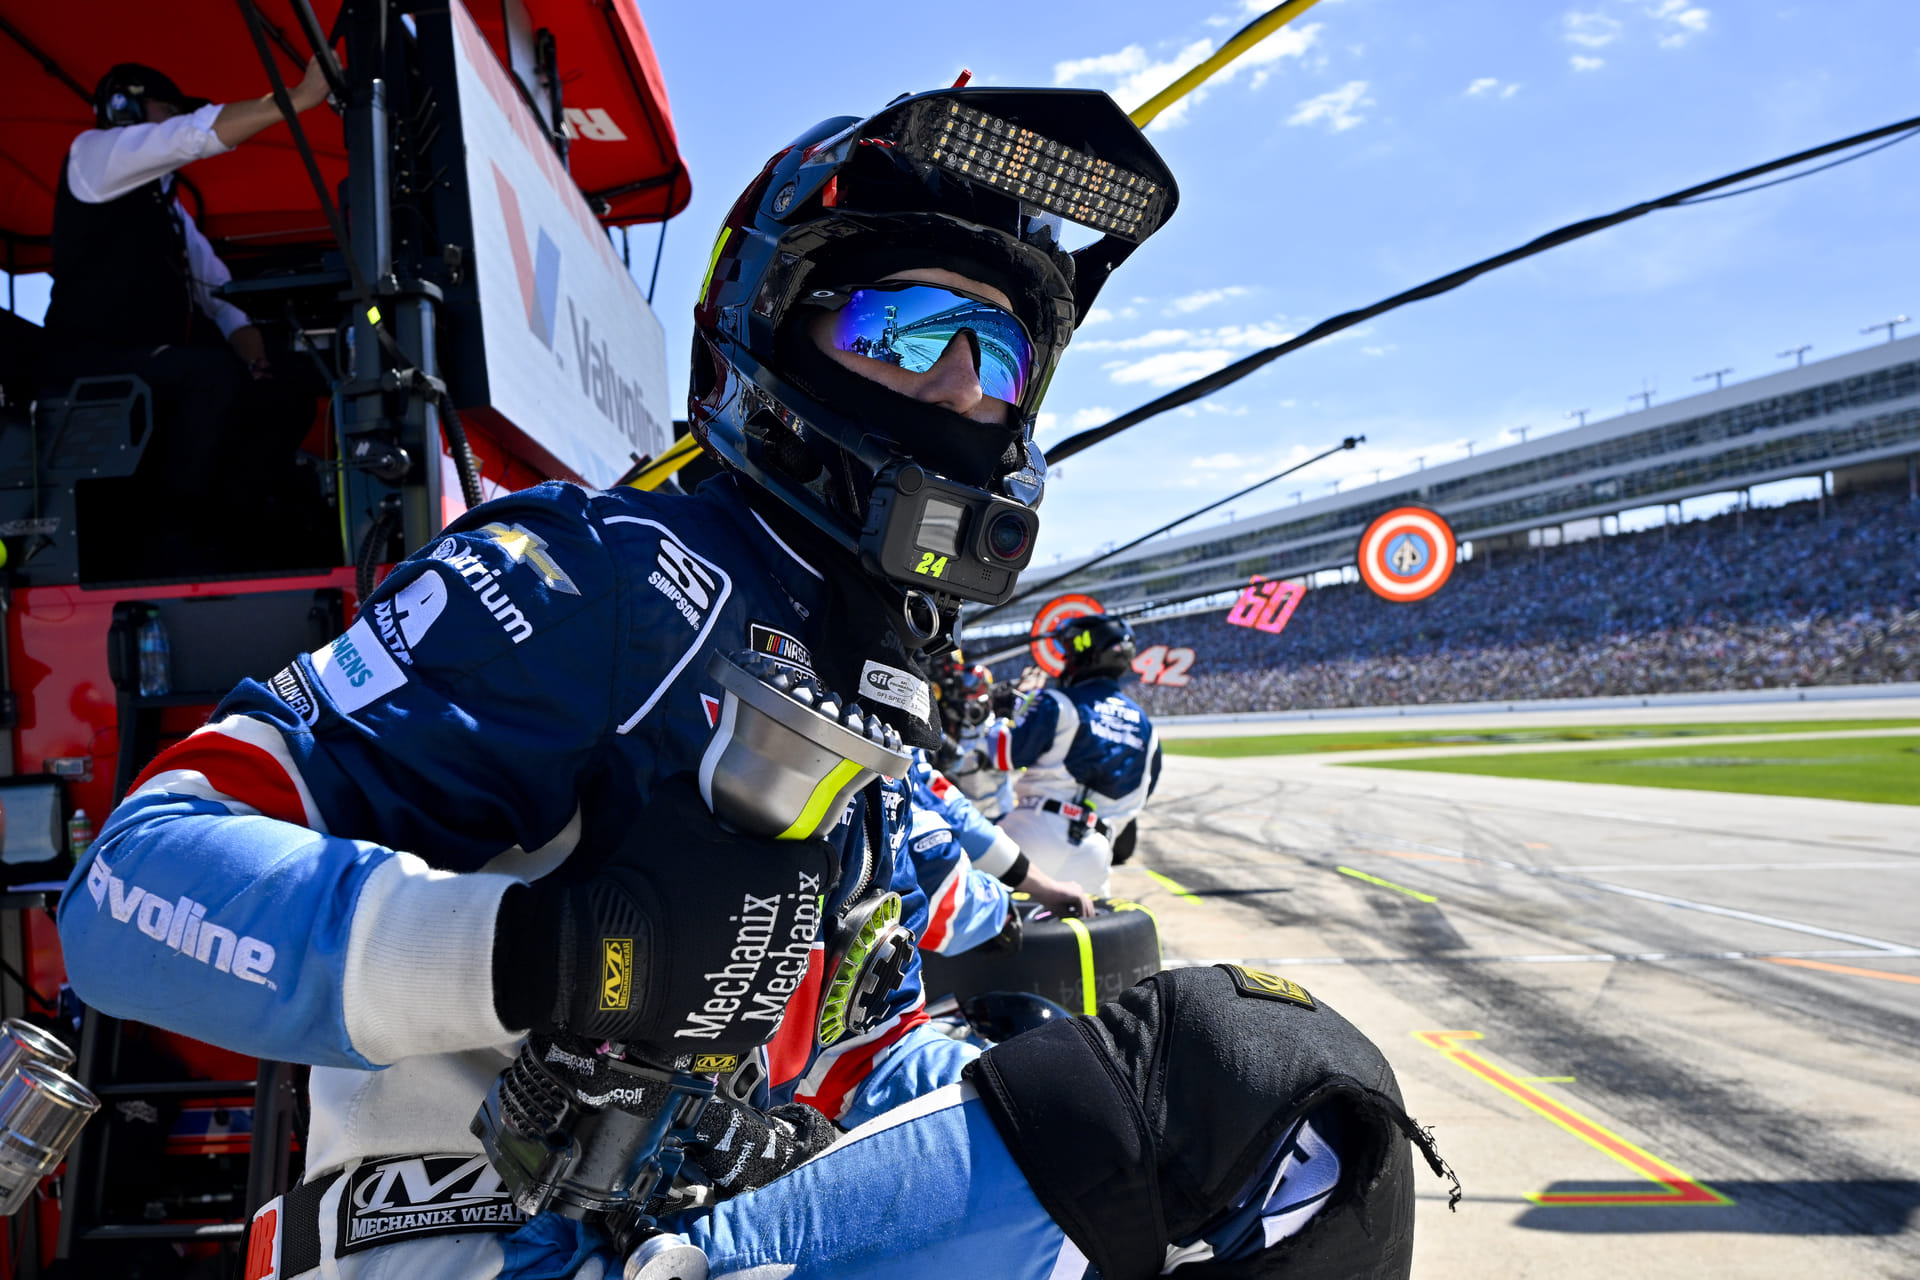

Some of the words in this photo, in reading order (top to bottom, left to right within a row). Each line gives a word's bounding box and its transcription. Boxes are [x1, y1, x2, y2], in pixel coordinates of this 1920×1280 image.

[915, 552, 948, 578] 24
[648, 571, 702, 630] SIMPSON
[1226, 574, 1307, 634] 60
[869, 673, 888, 686] sfi
[1131, 645, 1196, 687] 42
[887, 695, 906, 705] SPEC
[622, 942, 631, 967] WEAR
[674, 893, 781, 1040] Mechanix
[741, 871, 820, 1022] Mechanix
[350, 1211, 456, 1241] MECHANIX
[460, 1202, 532, 1222] WEAR
